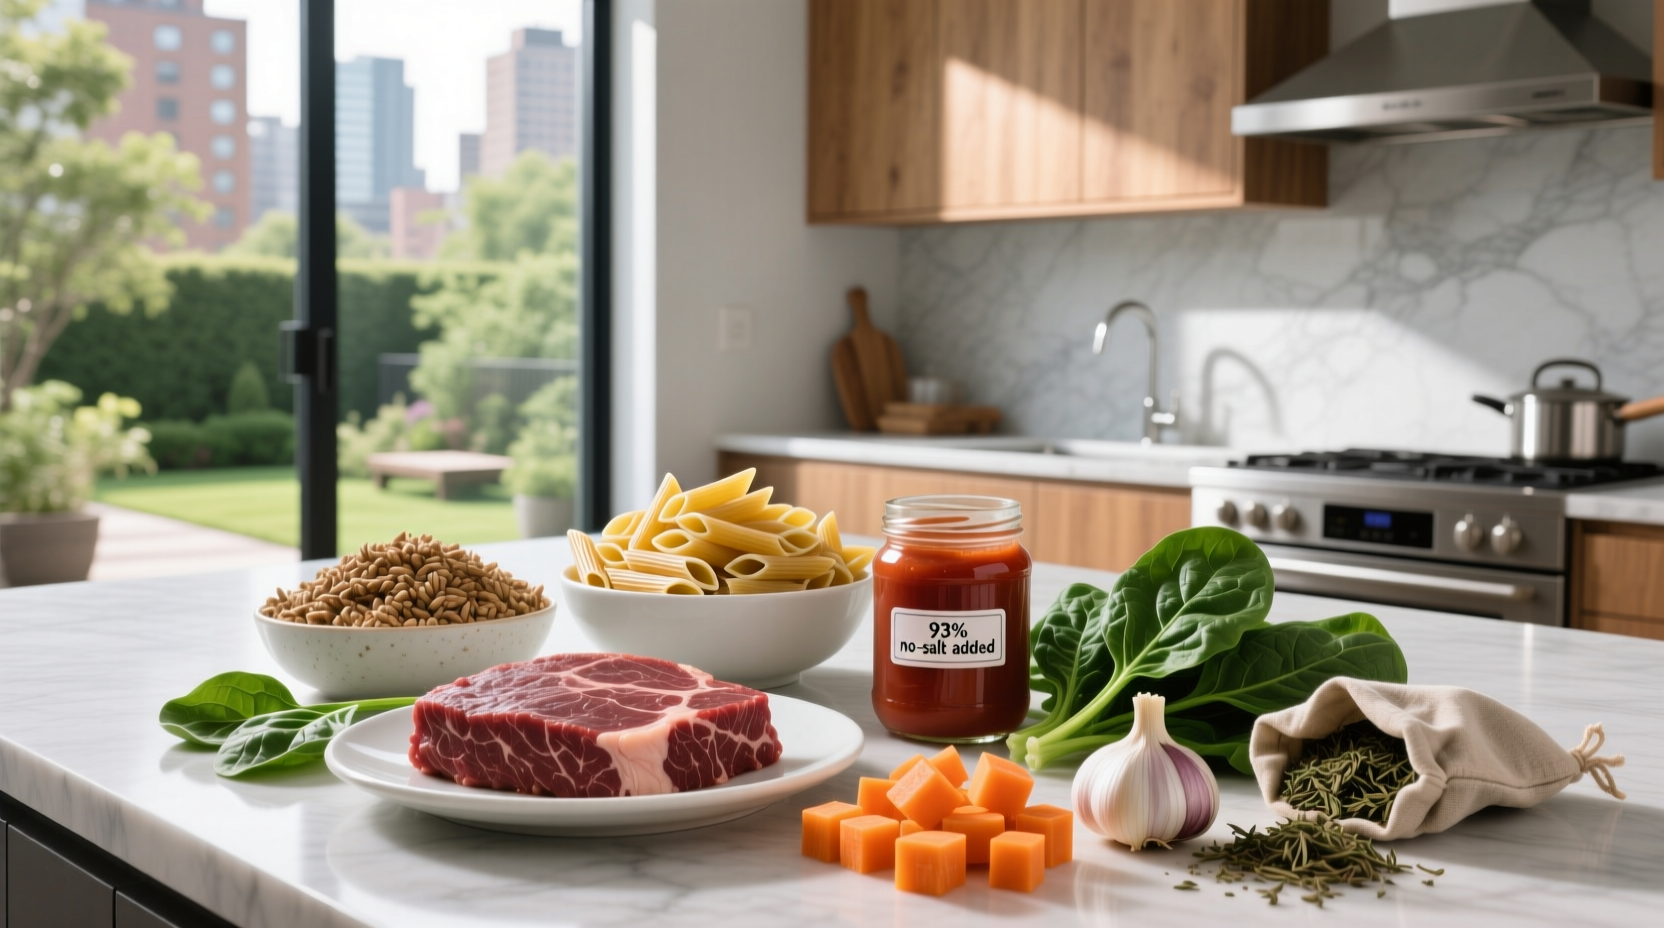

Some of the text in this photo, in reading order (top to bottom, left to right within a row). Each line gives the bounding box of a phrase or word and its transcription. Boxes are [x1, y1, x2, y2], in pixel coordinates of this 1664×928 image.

[929, 622, 968, 638] 93%
[900, 638, 995, 655] no-salt added
